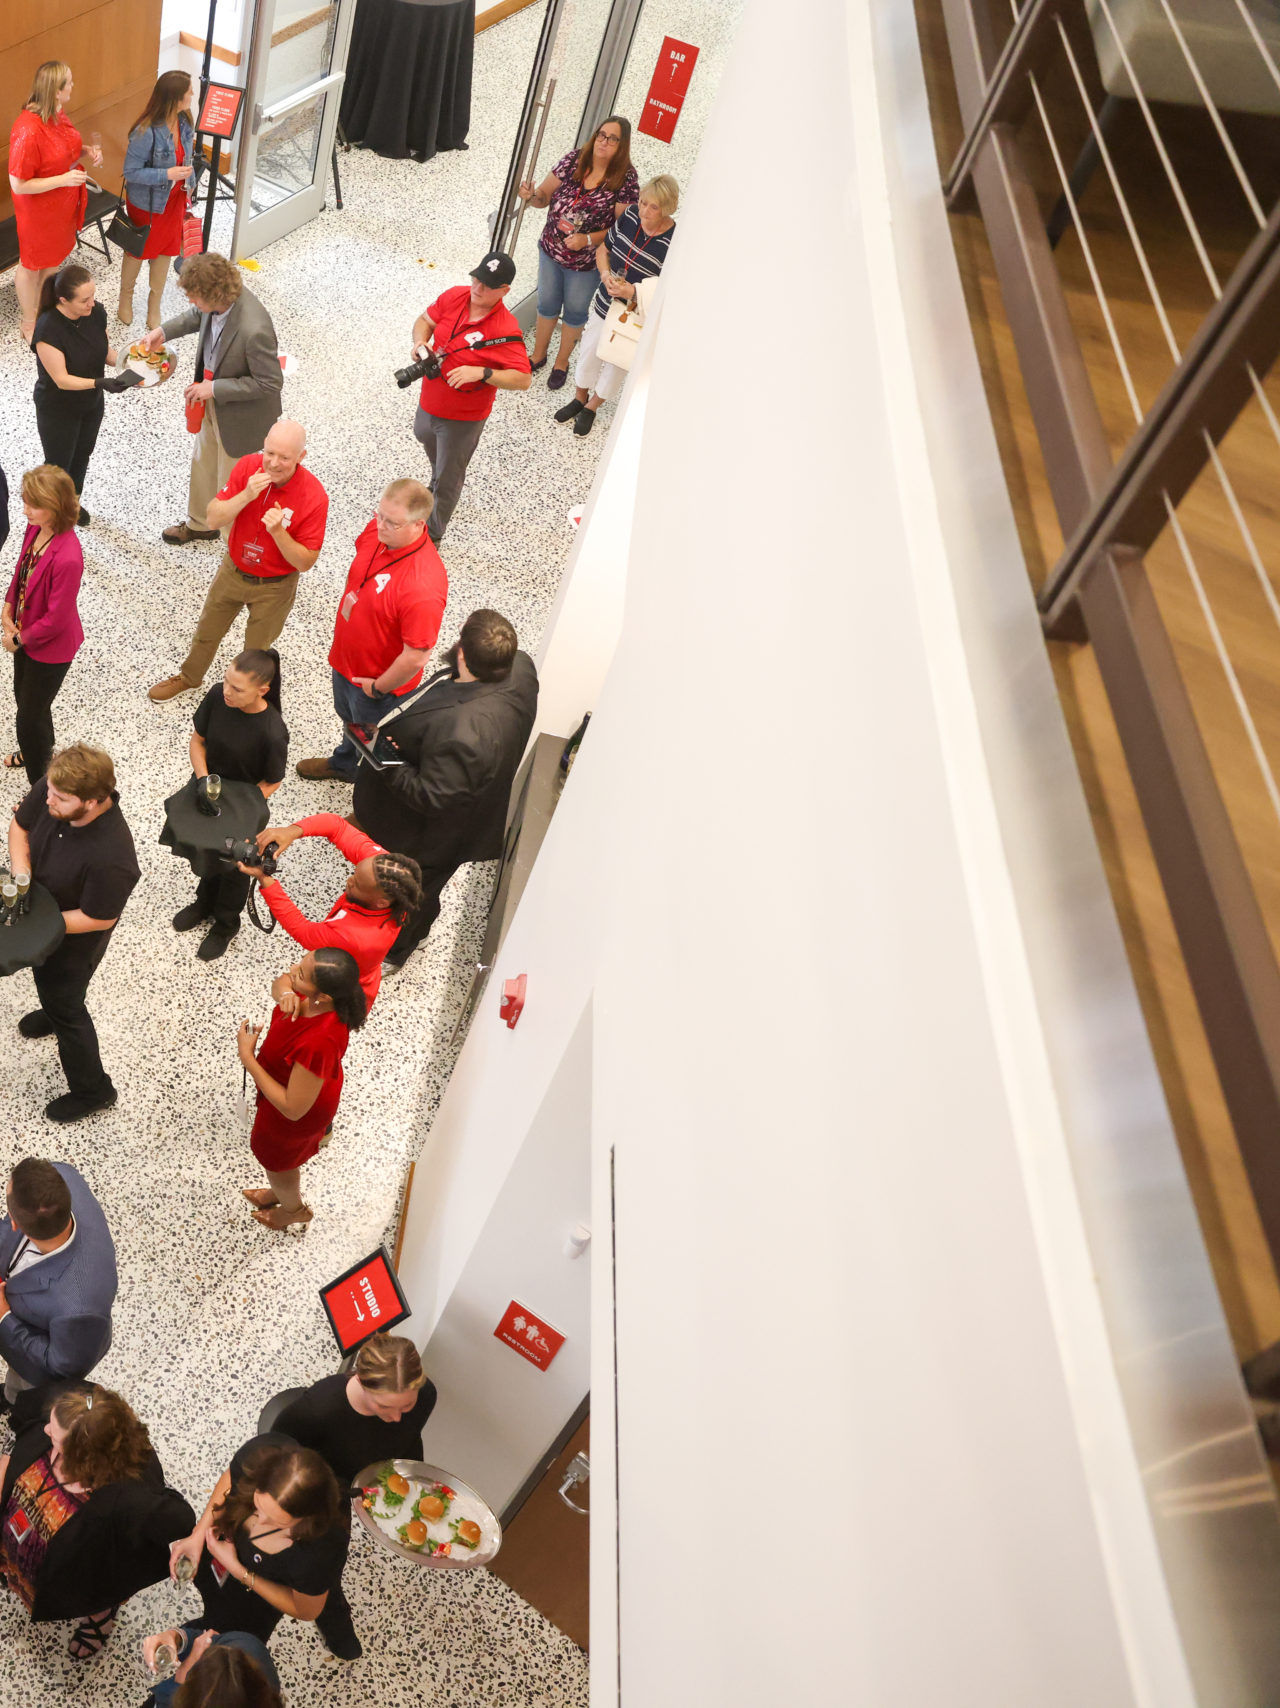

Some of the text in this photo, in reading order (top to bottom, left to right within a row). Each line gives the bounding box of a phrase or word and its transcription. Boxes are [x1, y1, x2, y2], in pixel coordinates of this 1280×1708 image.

[669, 50, 686, 63] BAR
[649, 98, 677, 114] BATHROOM
[486, 259, 500, 272] 4
[359, 1276, 381, 1318] STUDIO
[503, 1332, 541, 1362] RESTROOM
